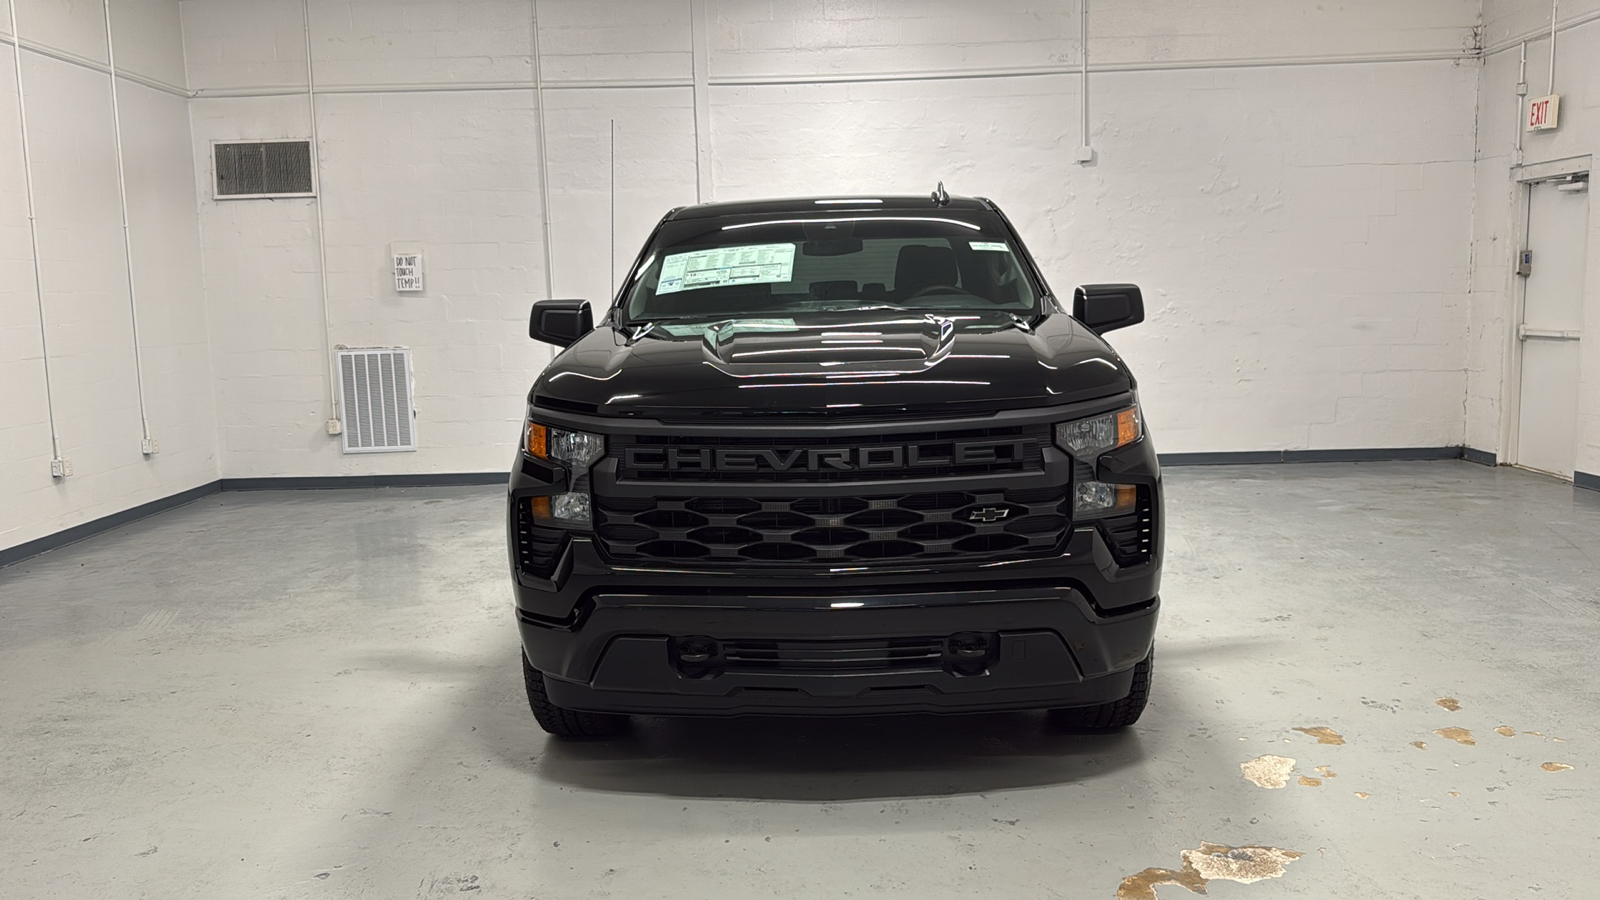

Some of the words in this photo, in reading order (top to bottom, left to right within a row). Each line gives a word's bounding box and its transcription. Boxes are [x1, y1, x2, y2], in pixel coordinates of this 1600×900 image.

[1530, 100, 1549, 126] EXIT
[396, 256, 403, 267] DO
[405, 256, 417, 267] NOT
[396, 267, 413, 277] TOUCH
[624, 438, 1038, 471] CHEVROLET
